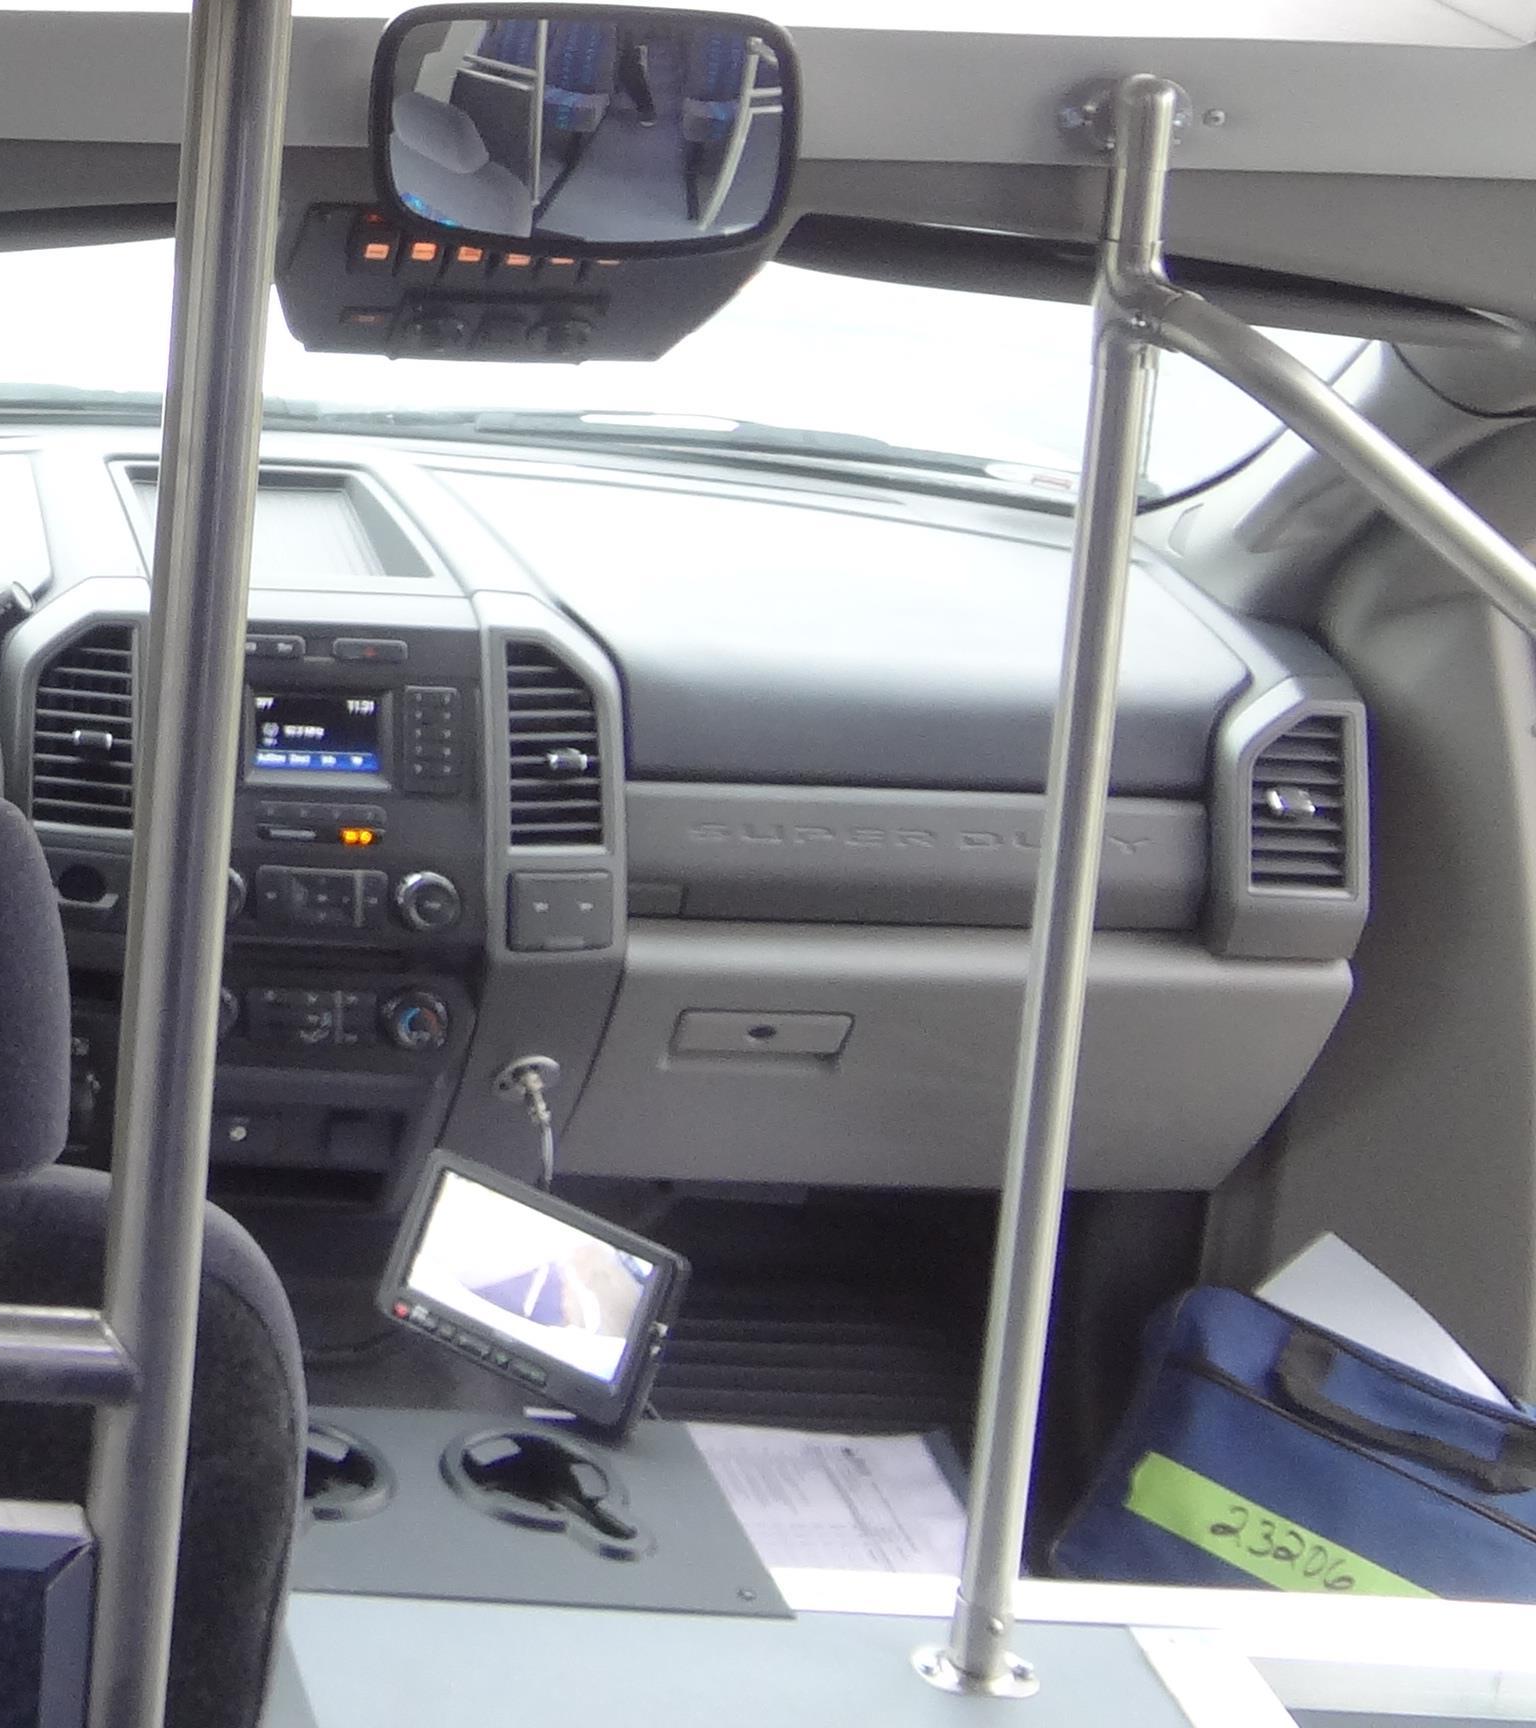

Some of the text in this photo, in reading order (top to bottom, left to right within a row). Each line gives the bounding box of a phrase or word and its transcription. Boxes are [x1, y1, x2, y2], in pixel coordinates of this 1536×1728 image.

[690, 822, 1158, 855] SUPER DUY
[1208, 1505, 1356, 1591] 23206
